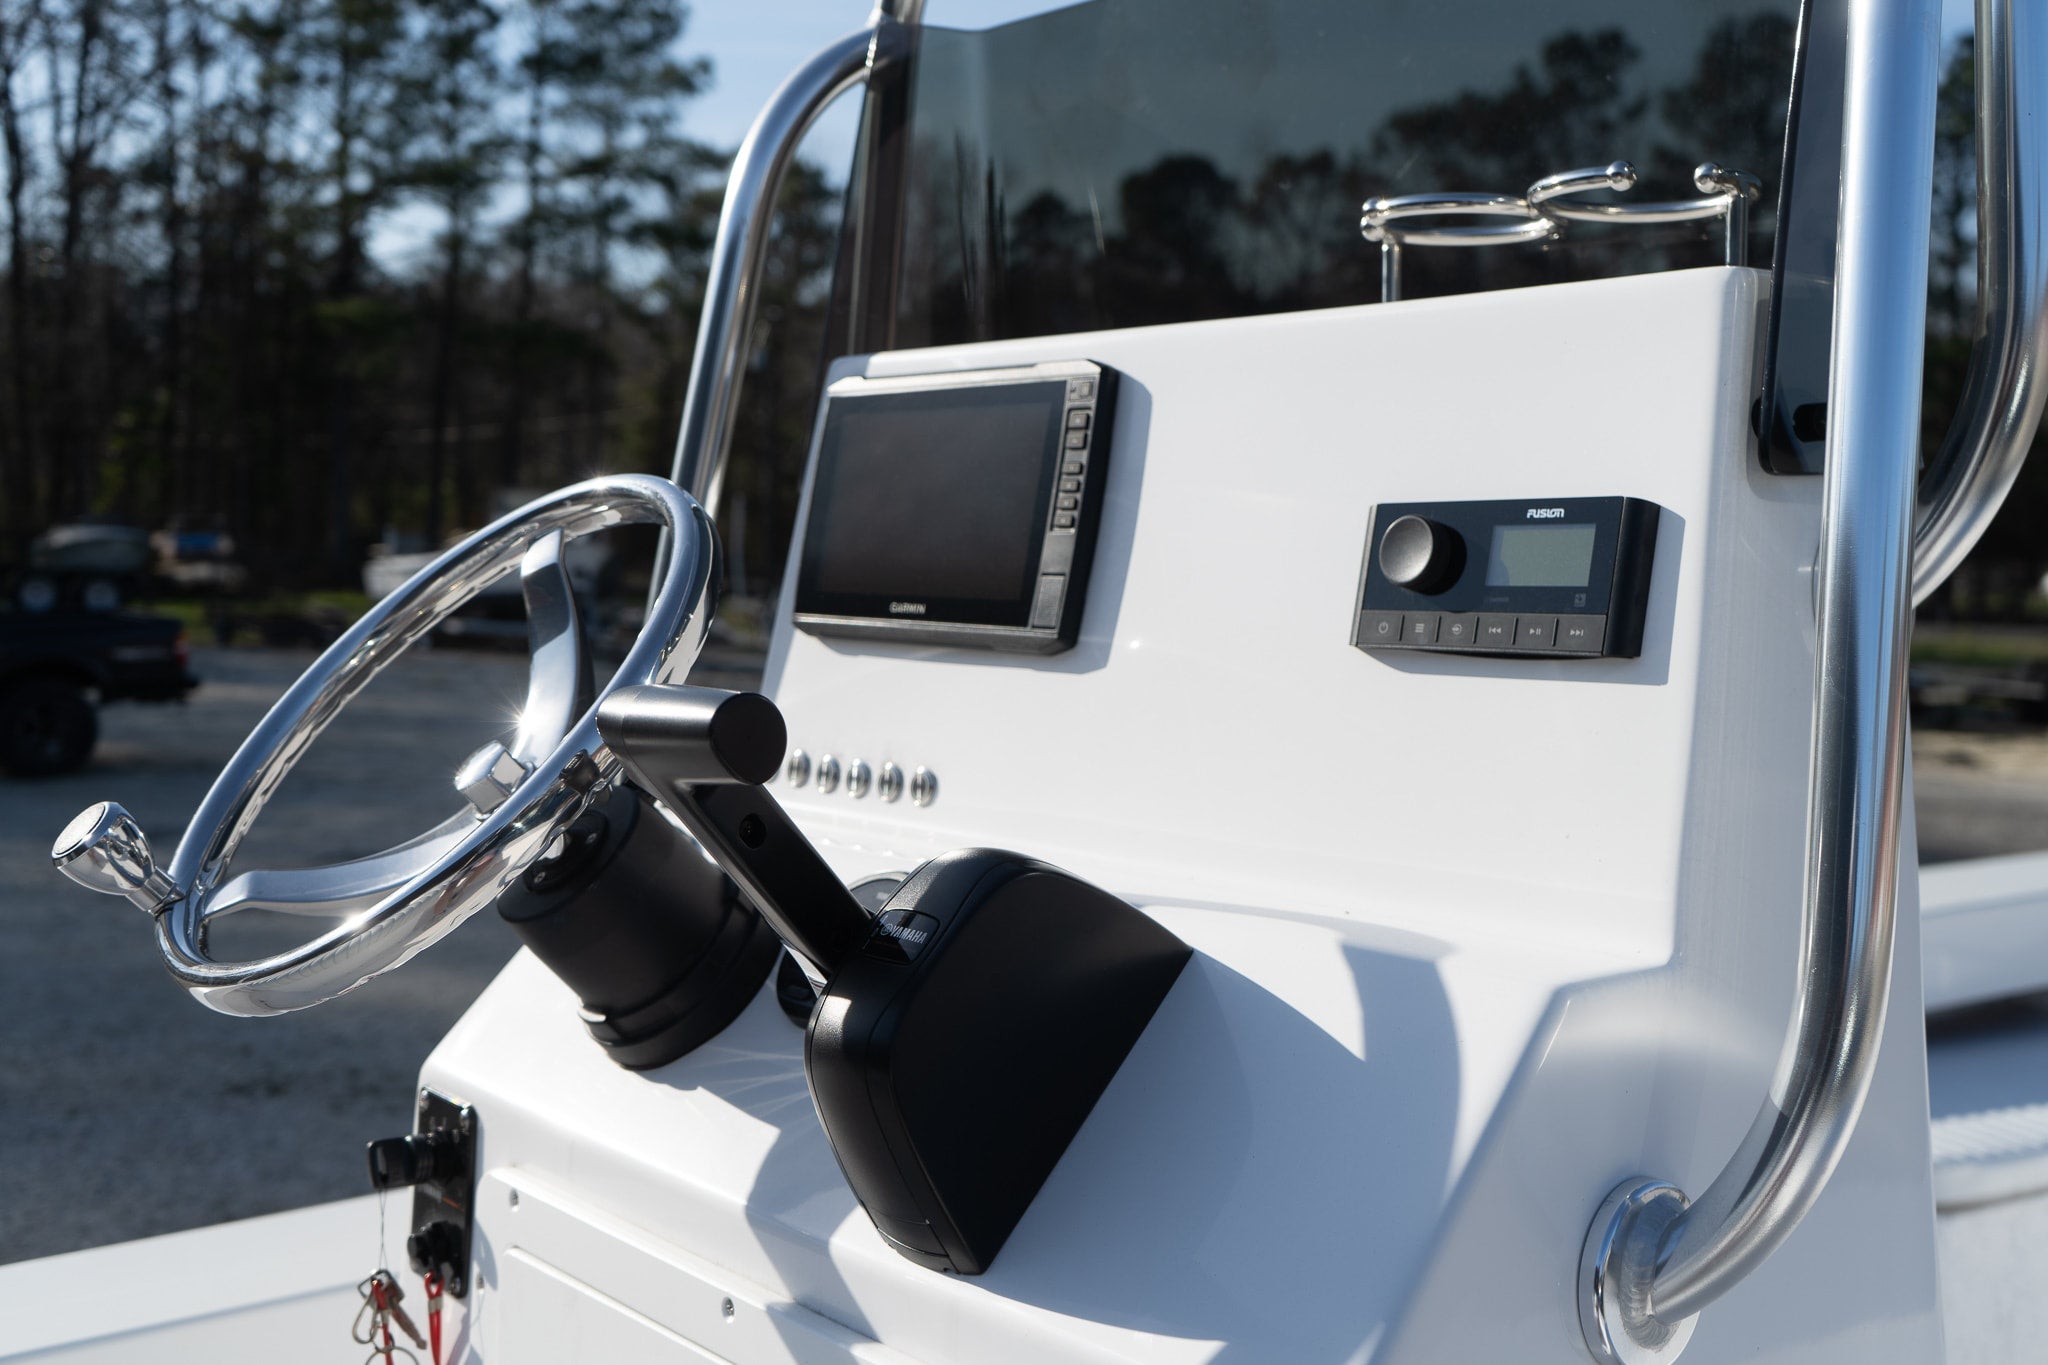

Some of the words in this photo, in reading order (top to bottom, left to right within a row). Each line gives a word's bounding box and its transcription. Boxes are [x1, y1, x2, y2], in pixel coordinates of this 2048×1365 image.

[1526, 508, 1565, 519] FUSION
[889, 601, 927, 615] GARMIN
[890, 925, 928, 944] YAMAHA
